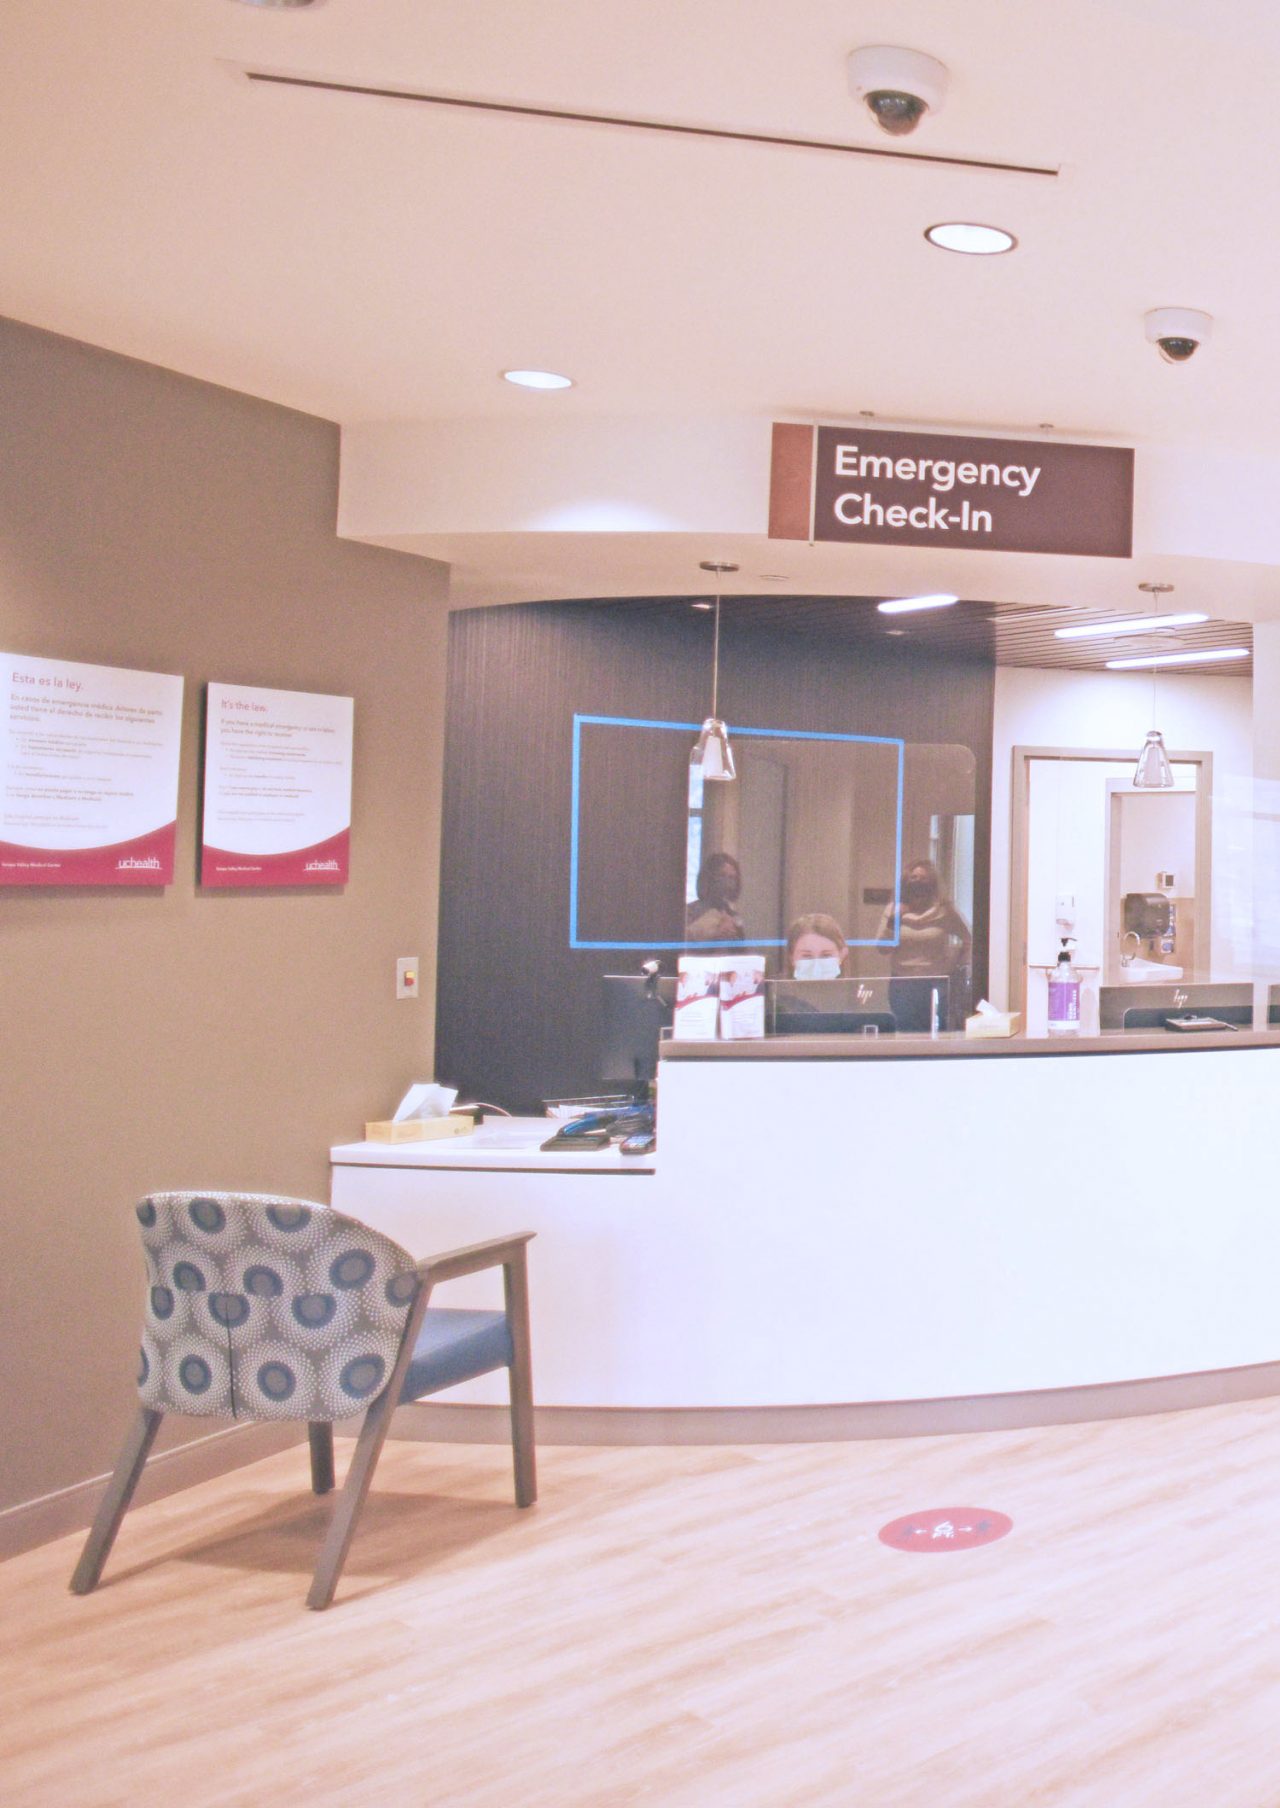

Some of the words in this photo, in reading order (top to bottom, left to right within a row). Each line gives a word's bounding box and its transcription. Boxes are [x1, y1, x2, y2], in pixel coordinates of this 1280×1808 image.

[834, 444, 1041, 497] Emergency
[833, 492, 993, 532] Check-In
[12, 672, 35, 685] Esta
[39, 677, 50, 686] es
[54, 676, 63, 688] la
[66, 677, 84, 692] ley.
[11, 693, 20, 701] En
[221, 699, 233, 710] It's
[235, 700, 250, 711] the
[231, 727, 244, 735] have
[245, 728, 253, 736] the
[118, 856, 160, 869] uchealth
[306, 859, 338, 871] uchealth
[857, 983, 873, 1005] hp
[1173, 989, 1188, 1008] hp
